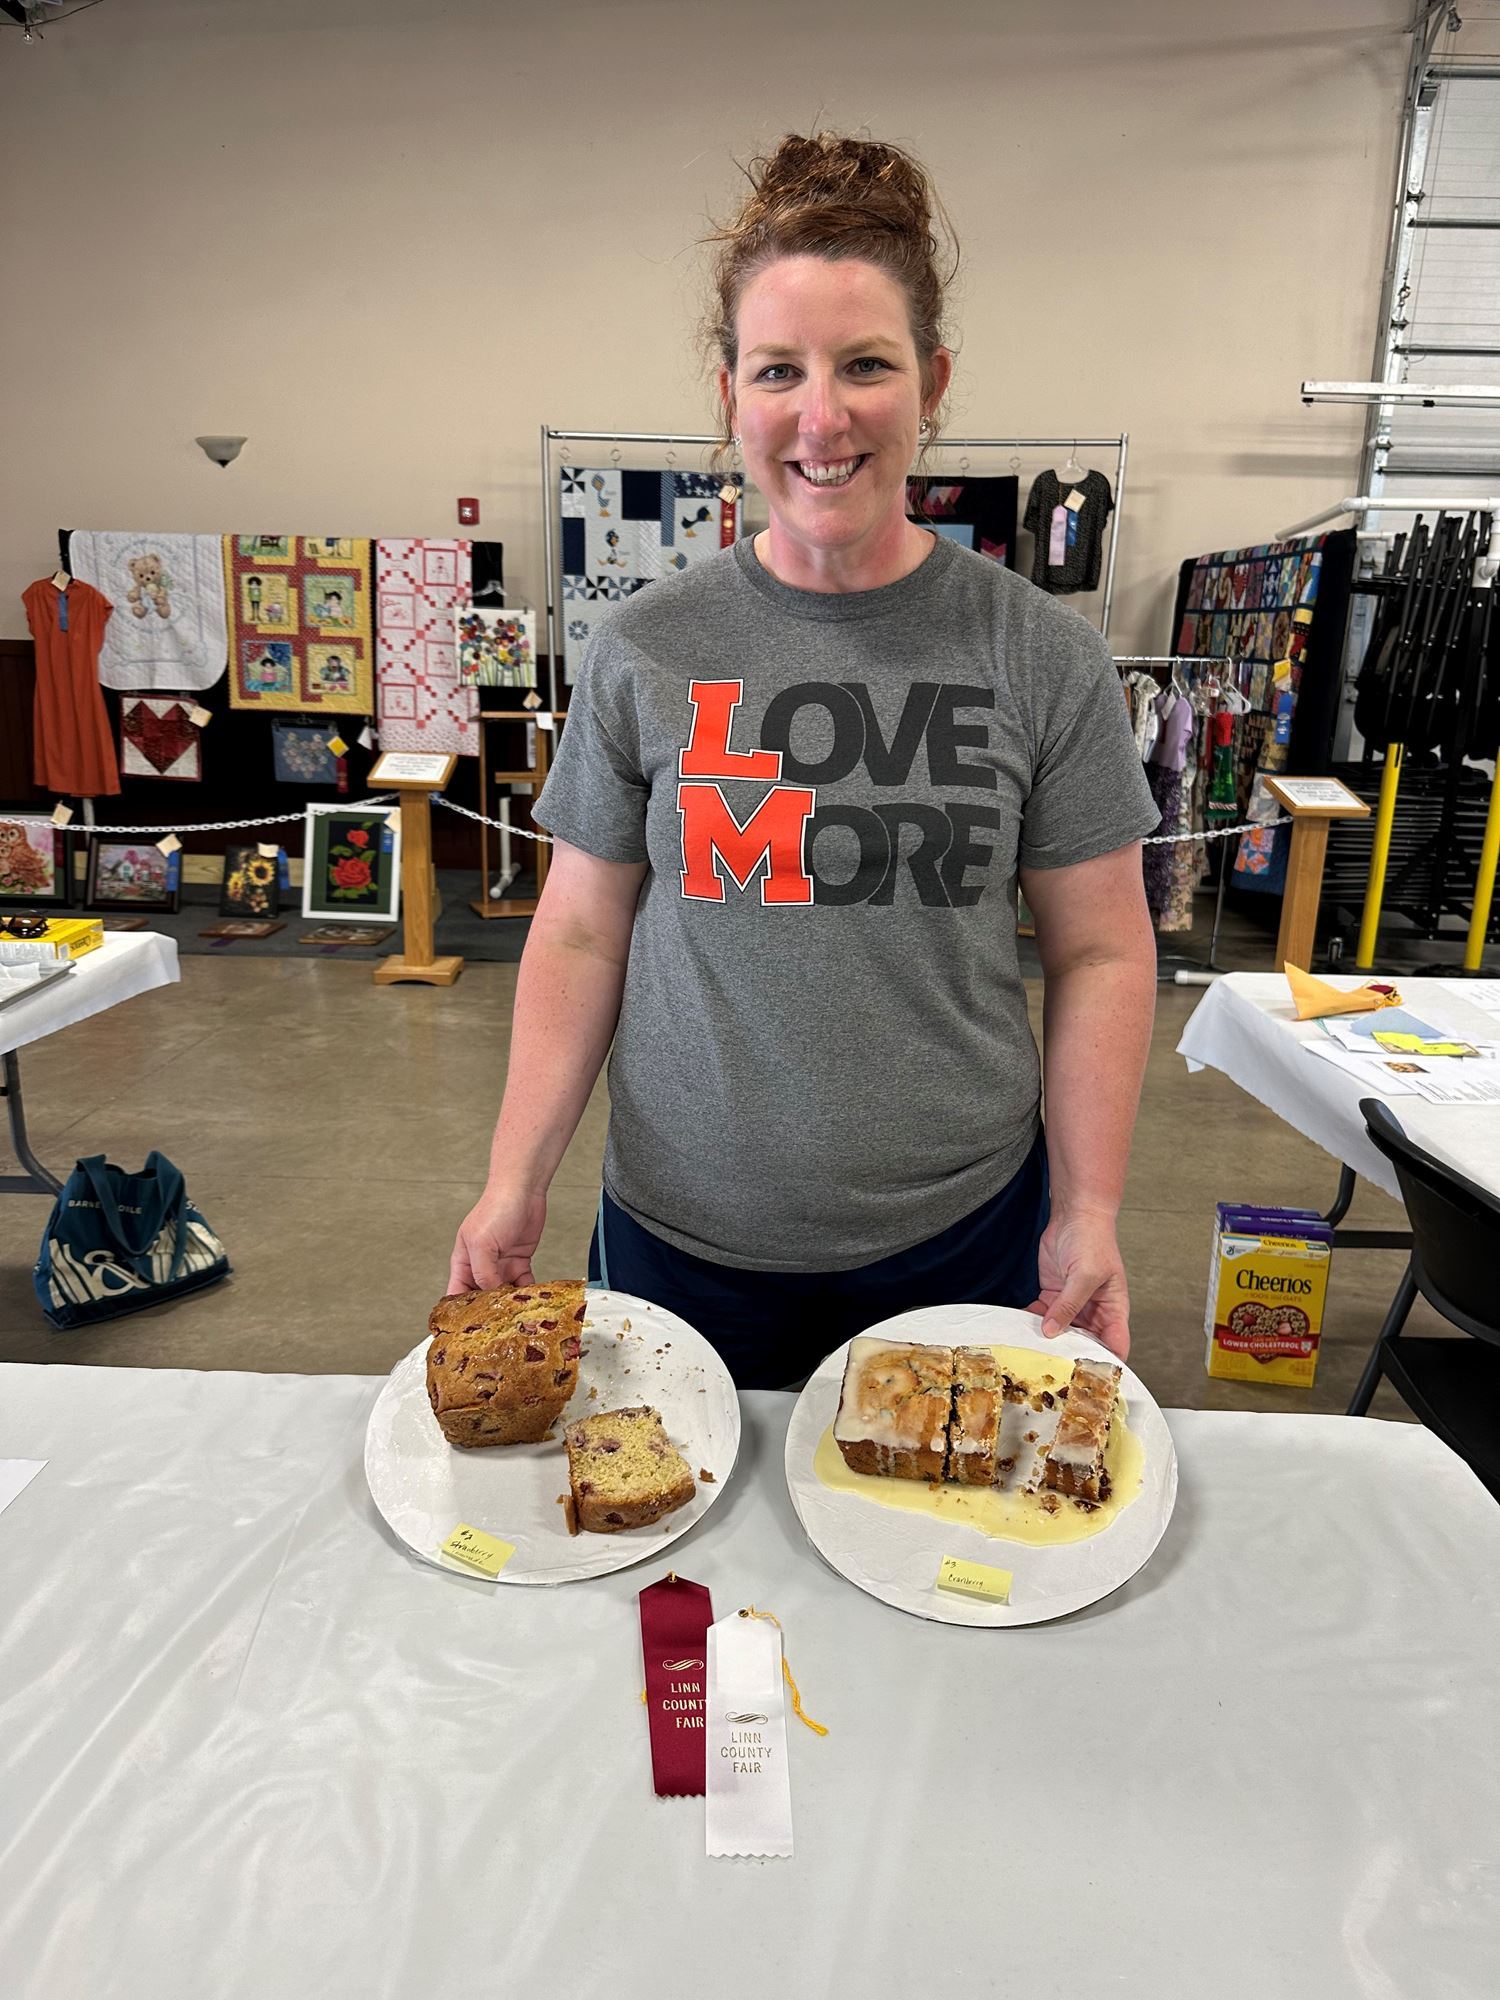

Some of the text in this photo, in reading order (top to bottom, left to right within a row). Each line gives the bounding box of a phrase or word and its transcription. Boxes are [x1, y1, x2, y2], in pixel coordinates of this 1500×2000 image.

[678, 678, 998, 791] LOVE
[676, 783, 1001, 908] MORE
[68, 1200, 101, 1209] BARNE
[1236, 1268, 1312, 1296] Cheerios
[1223, 1338, 1249, 1349] LOWER
[1249, 1340, 1300, 1350] CHOLESTEROL
[671, 1682, 701, 1693] LINN
[676, 1716, 705, 1729] FAIR
[731, 1731, 762, 1743] LINN
[720, 1746, 772, 1758] COUNTY
[732, 1761, 762, 1774] FAIR
